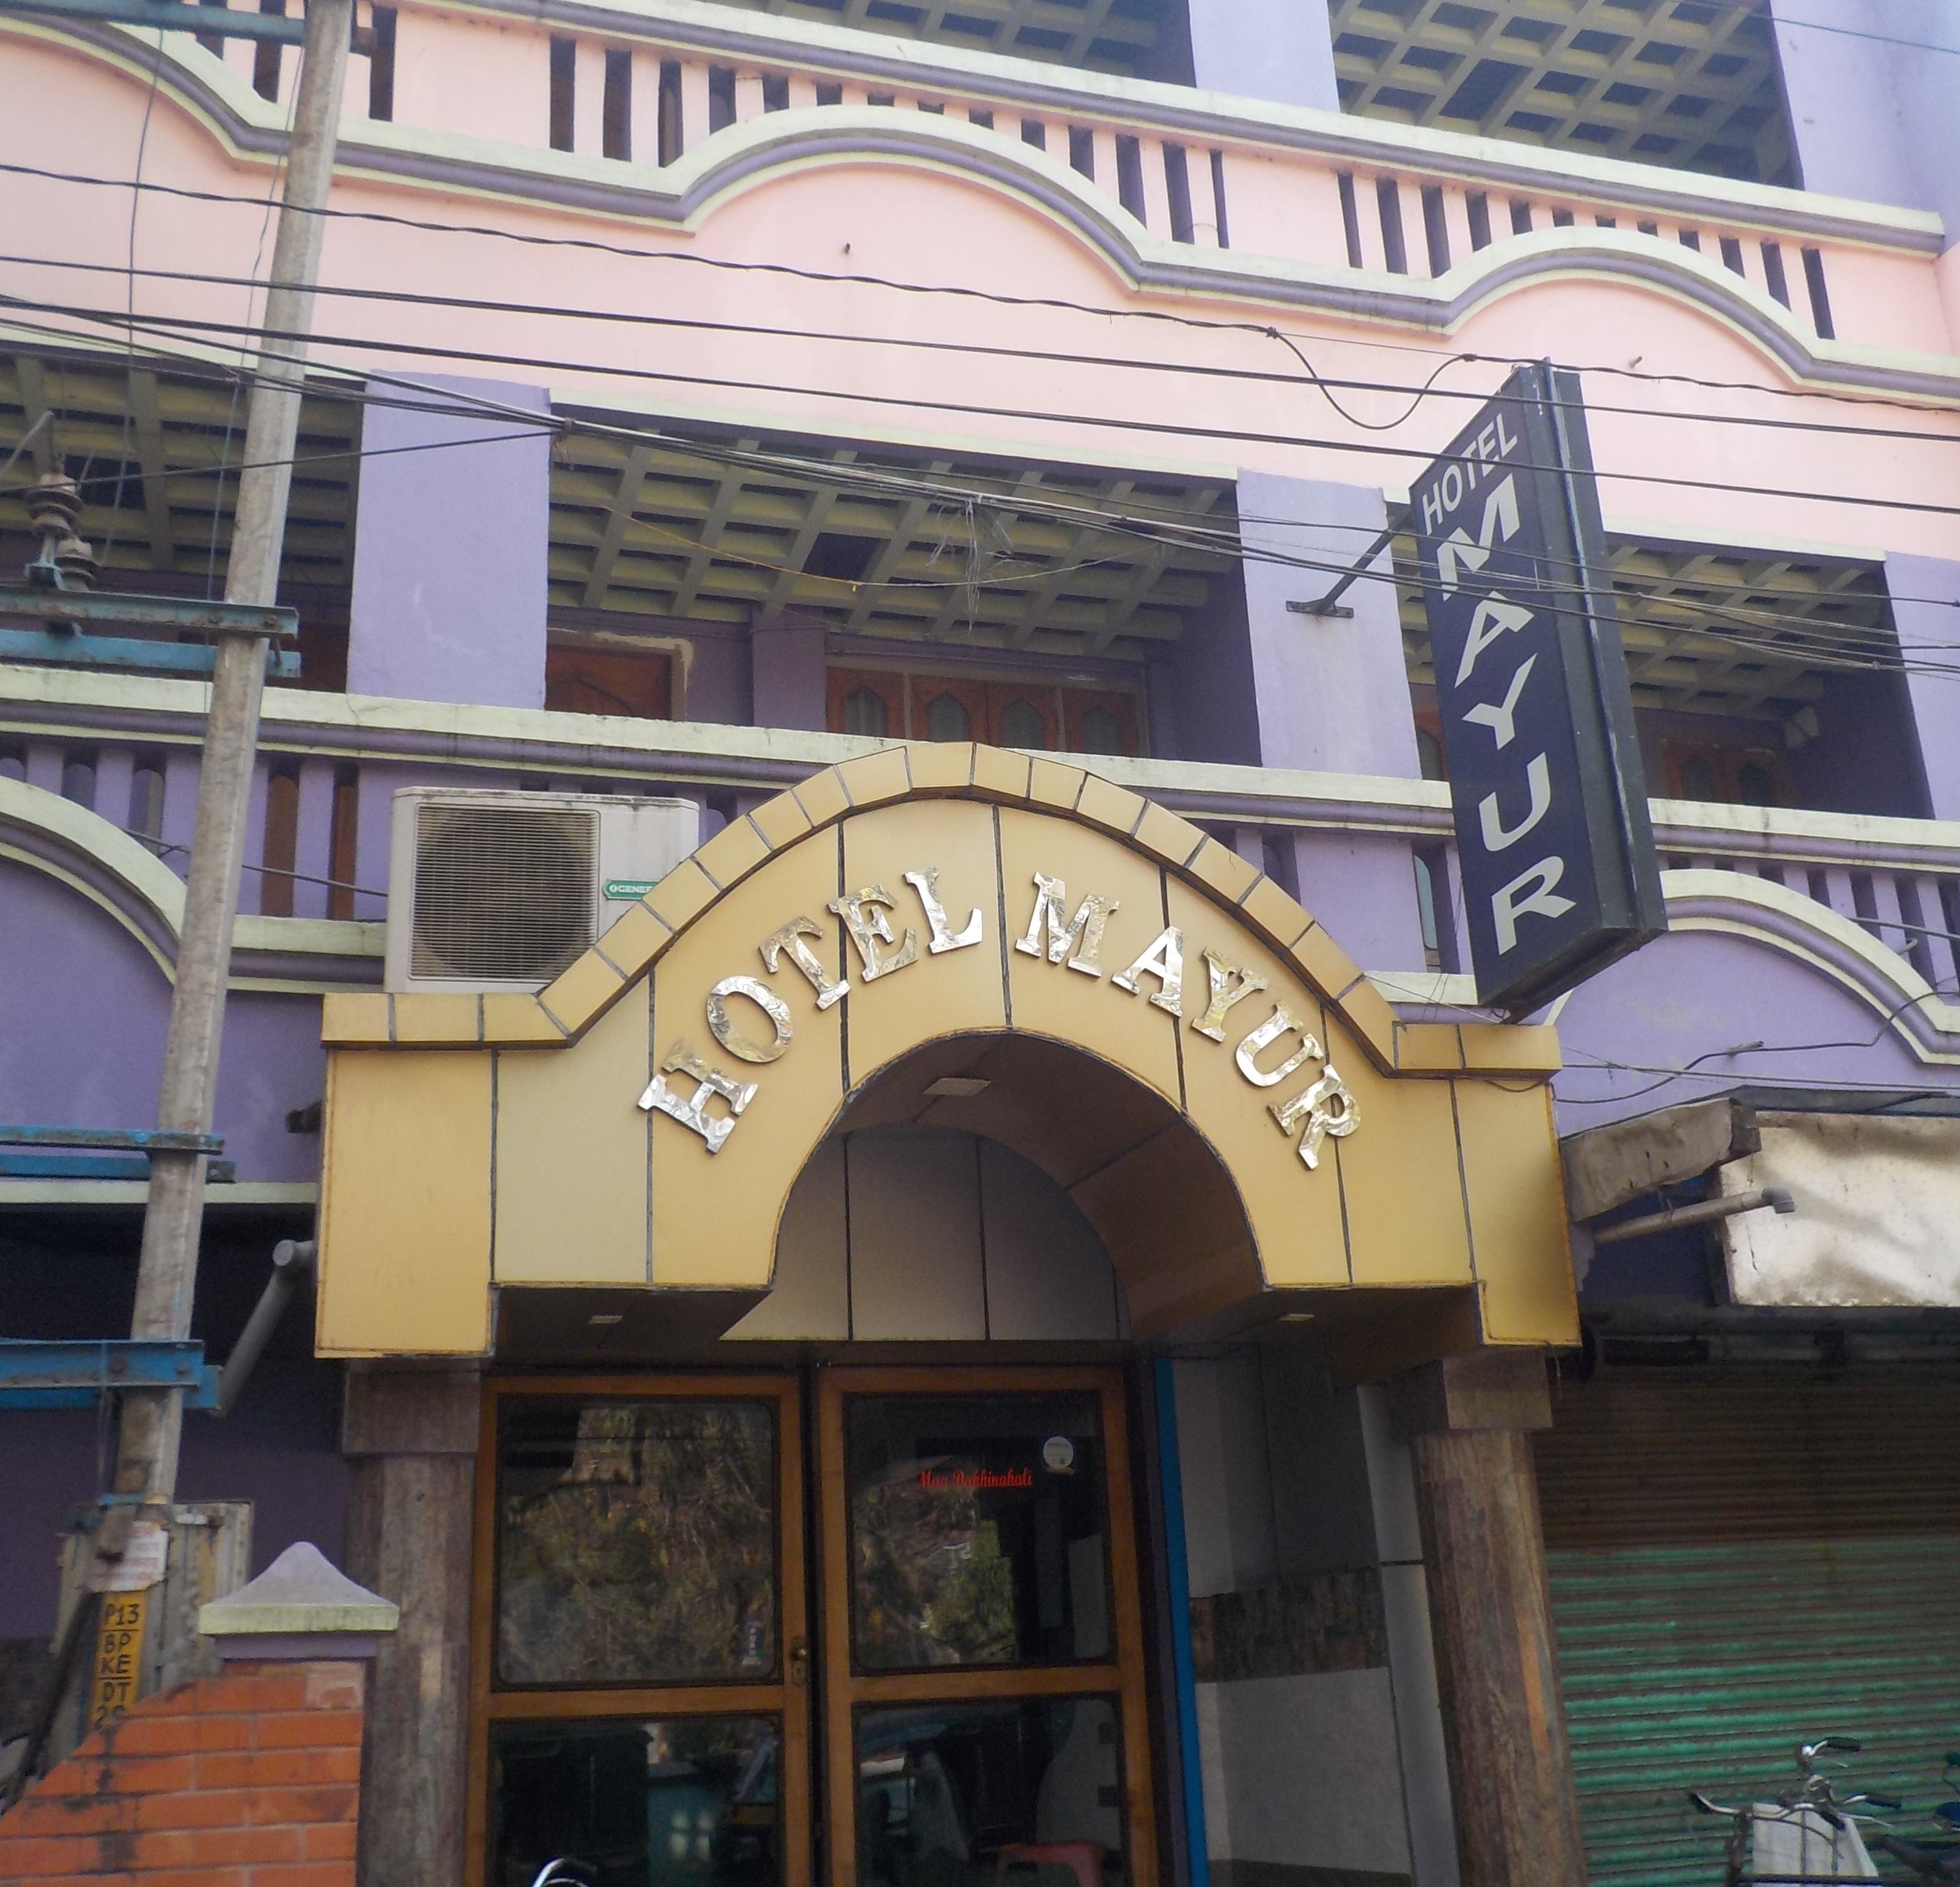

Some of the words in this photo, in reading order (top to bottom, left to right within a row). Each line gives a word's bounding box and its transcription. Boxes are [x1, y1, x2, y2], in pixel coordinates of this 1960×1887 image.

[1422, 413, 1518, 536] HOTEL
[1437, 473, 1576, 955] MAYUR
[637, 867, 983, 1155] HOTEL
[1015, 871, 1361, 1170] MAYUR
[101, 1655, 131, 1674] KE
[105, 1602, 139, 1626] P13
